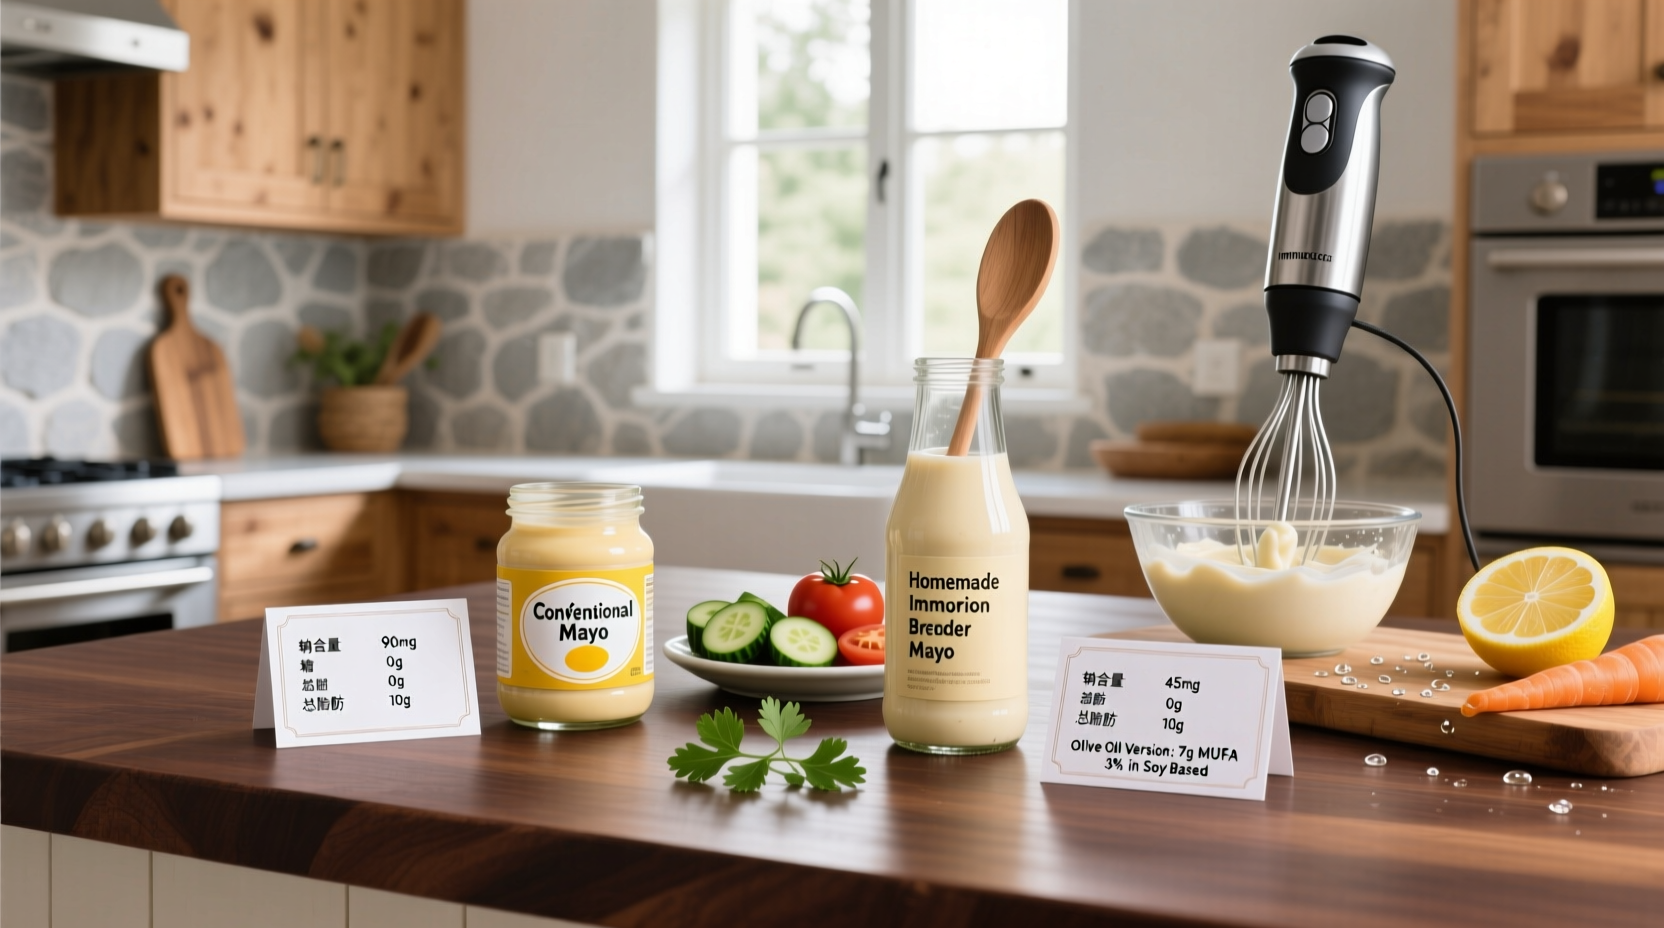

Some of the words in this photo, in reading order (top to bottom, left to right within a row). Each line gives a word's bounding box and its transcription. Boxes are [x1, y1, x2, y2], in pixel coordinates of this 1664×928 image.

[909, 571, 999, 590] Homemade
[533, 600, 633, 620] Conventional
[909, 594, 990, 613] Immorion
[381, 635, 417, 650] 90mg
[559, 623, 609, 644] Mayo
[909, 641, 954, 663] Mayo
[386, 656, 403, 671] 0g
[388, 675, 405, 689] 0g
[1165, 676, 1200, 694] 45mg
[389, 694, 411, 709] 10g
[1165, 697, 1183, 713] 0g
[1162, 717, 1184, 734] 10g
[1125, 742, 1175, 757] Version:
[1178, 745, 1194, 761] 7g
[1198, 746, 1238, 761] MUFA
[1128, 759, 1139, 772] in
[1143, 760, 1167, 777] Soy
[1170, 762, 1209, 777] Based
